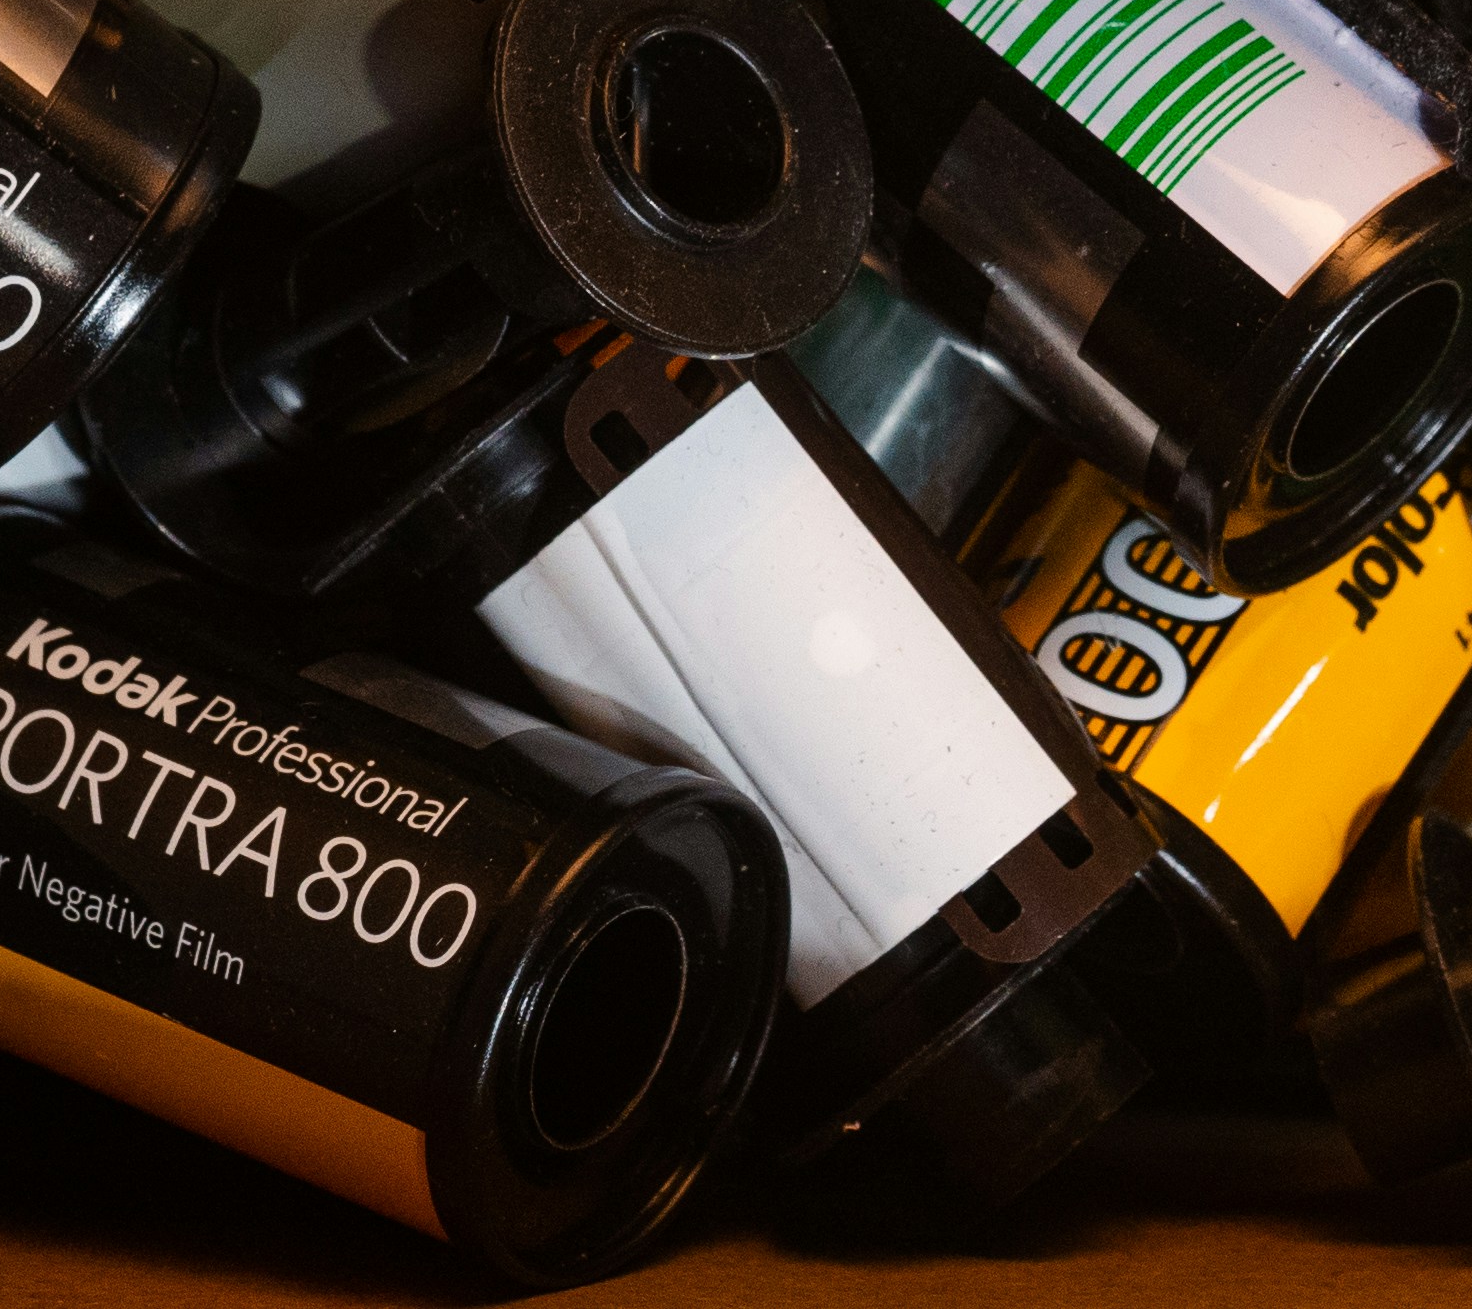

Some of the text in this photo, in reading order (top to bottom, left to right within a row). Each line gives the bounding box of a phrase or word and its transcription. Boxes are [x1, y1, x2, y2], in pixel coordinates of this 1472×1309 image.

[1036, 515, 1251, 722] 00
[1337, 483, 1460, 633] olor
[4, 615, 472, 840] Kodak Professional
[16, 849, 167, 953] Negative
[174, 918, 247, 986] Film
[295, 832, 480, 970] 800
